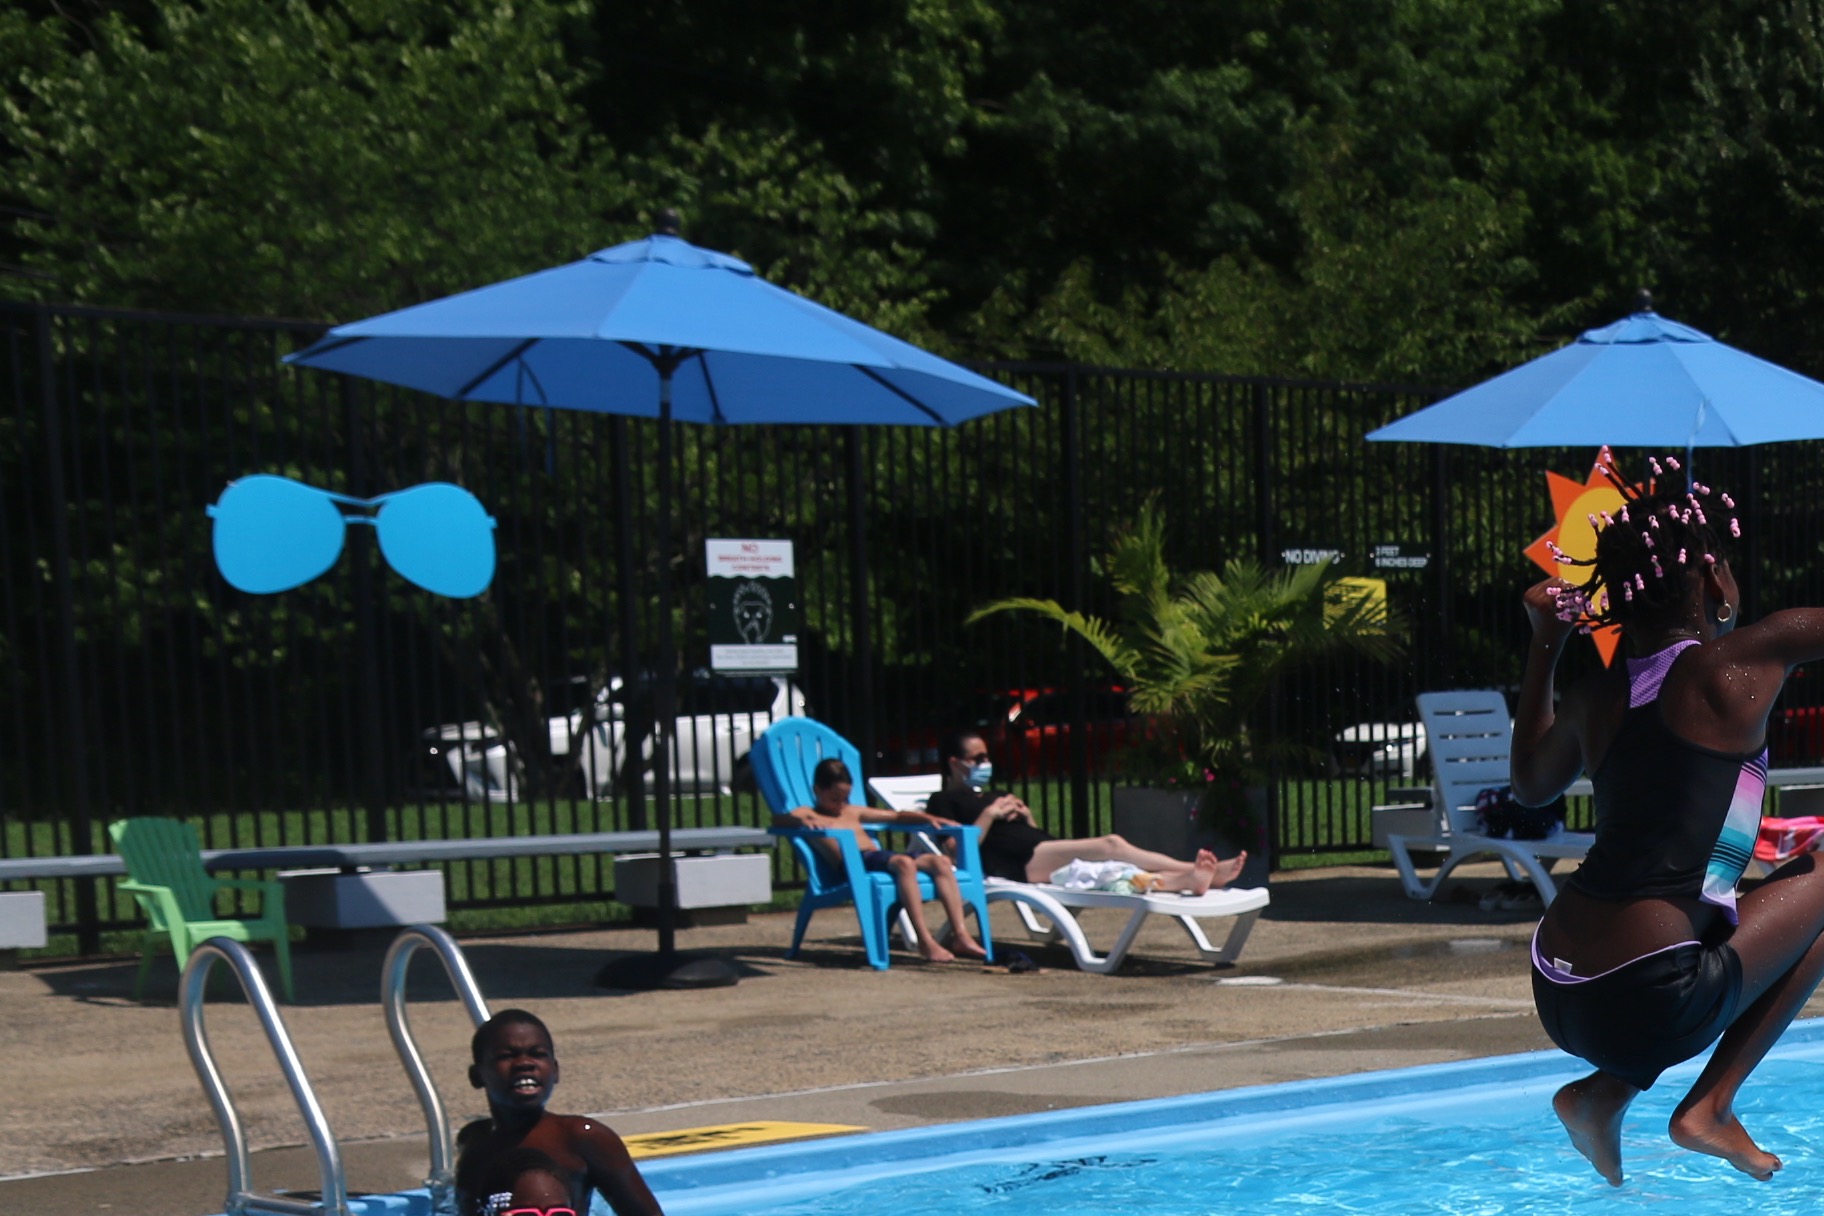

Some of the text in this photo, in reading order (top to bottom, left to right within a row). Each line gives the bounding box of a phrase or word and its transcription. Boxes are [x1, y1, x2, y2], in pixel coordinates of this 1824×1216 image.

[1380, 545, 1399, 556] FEET
[1285, 549, 1302, 564] NO
[1380, 557, 1407, 567] INCHES
[1407, 557, 1428, 567] DEEP
